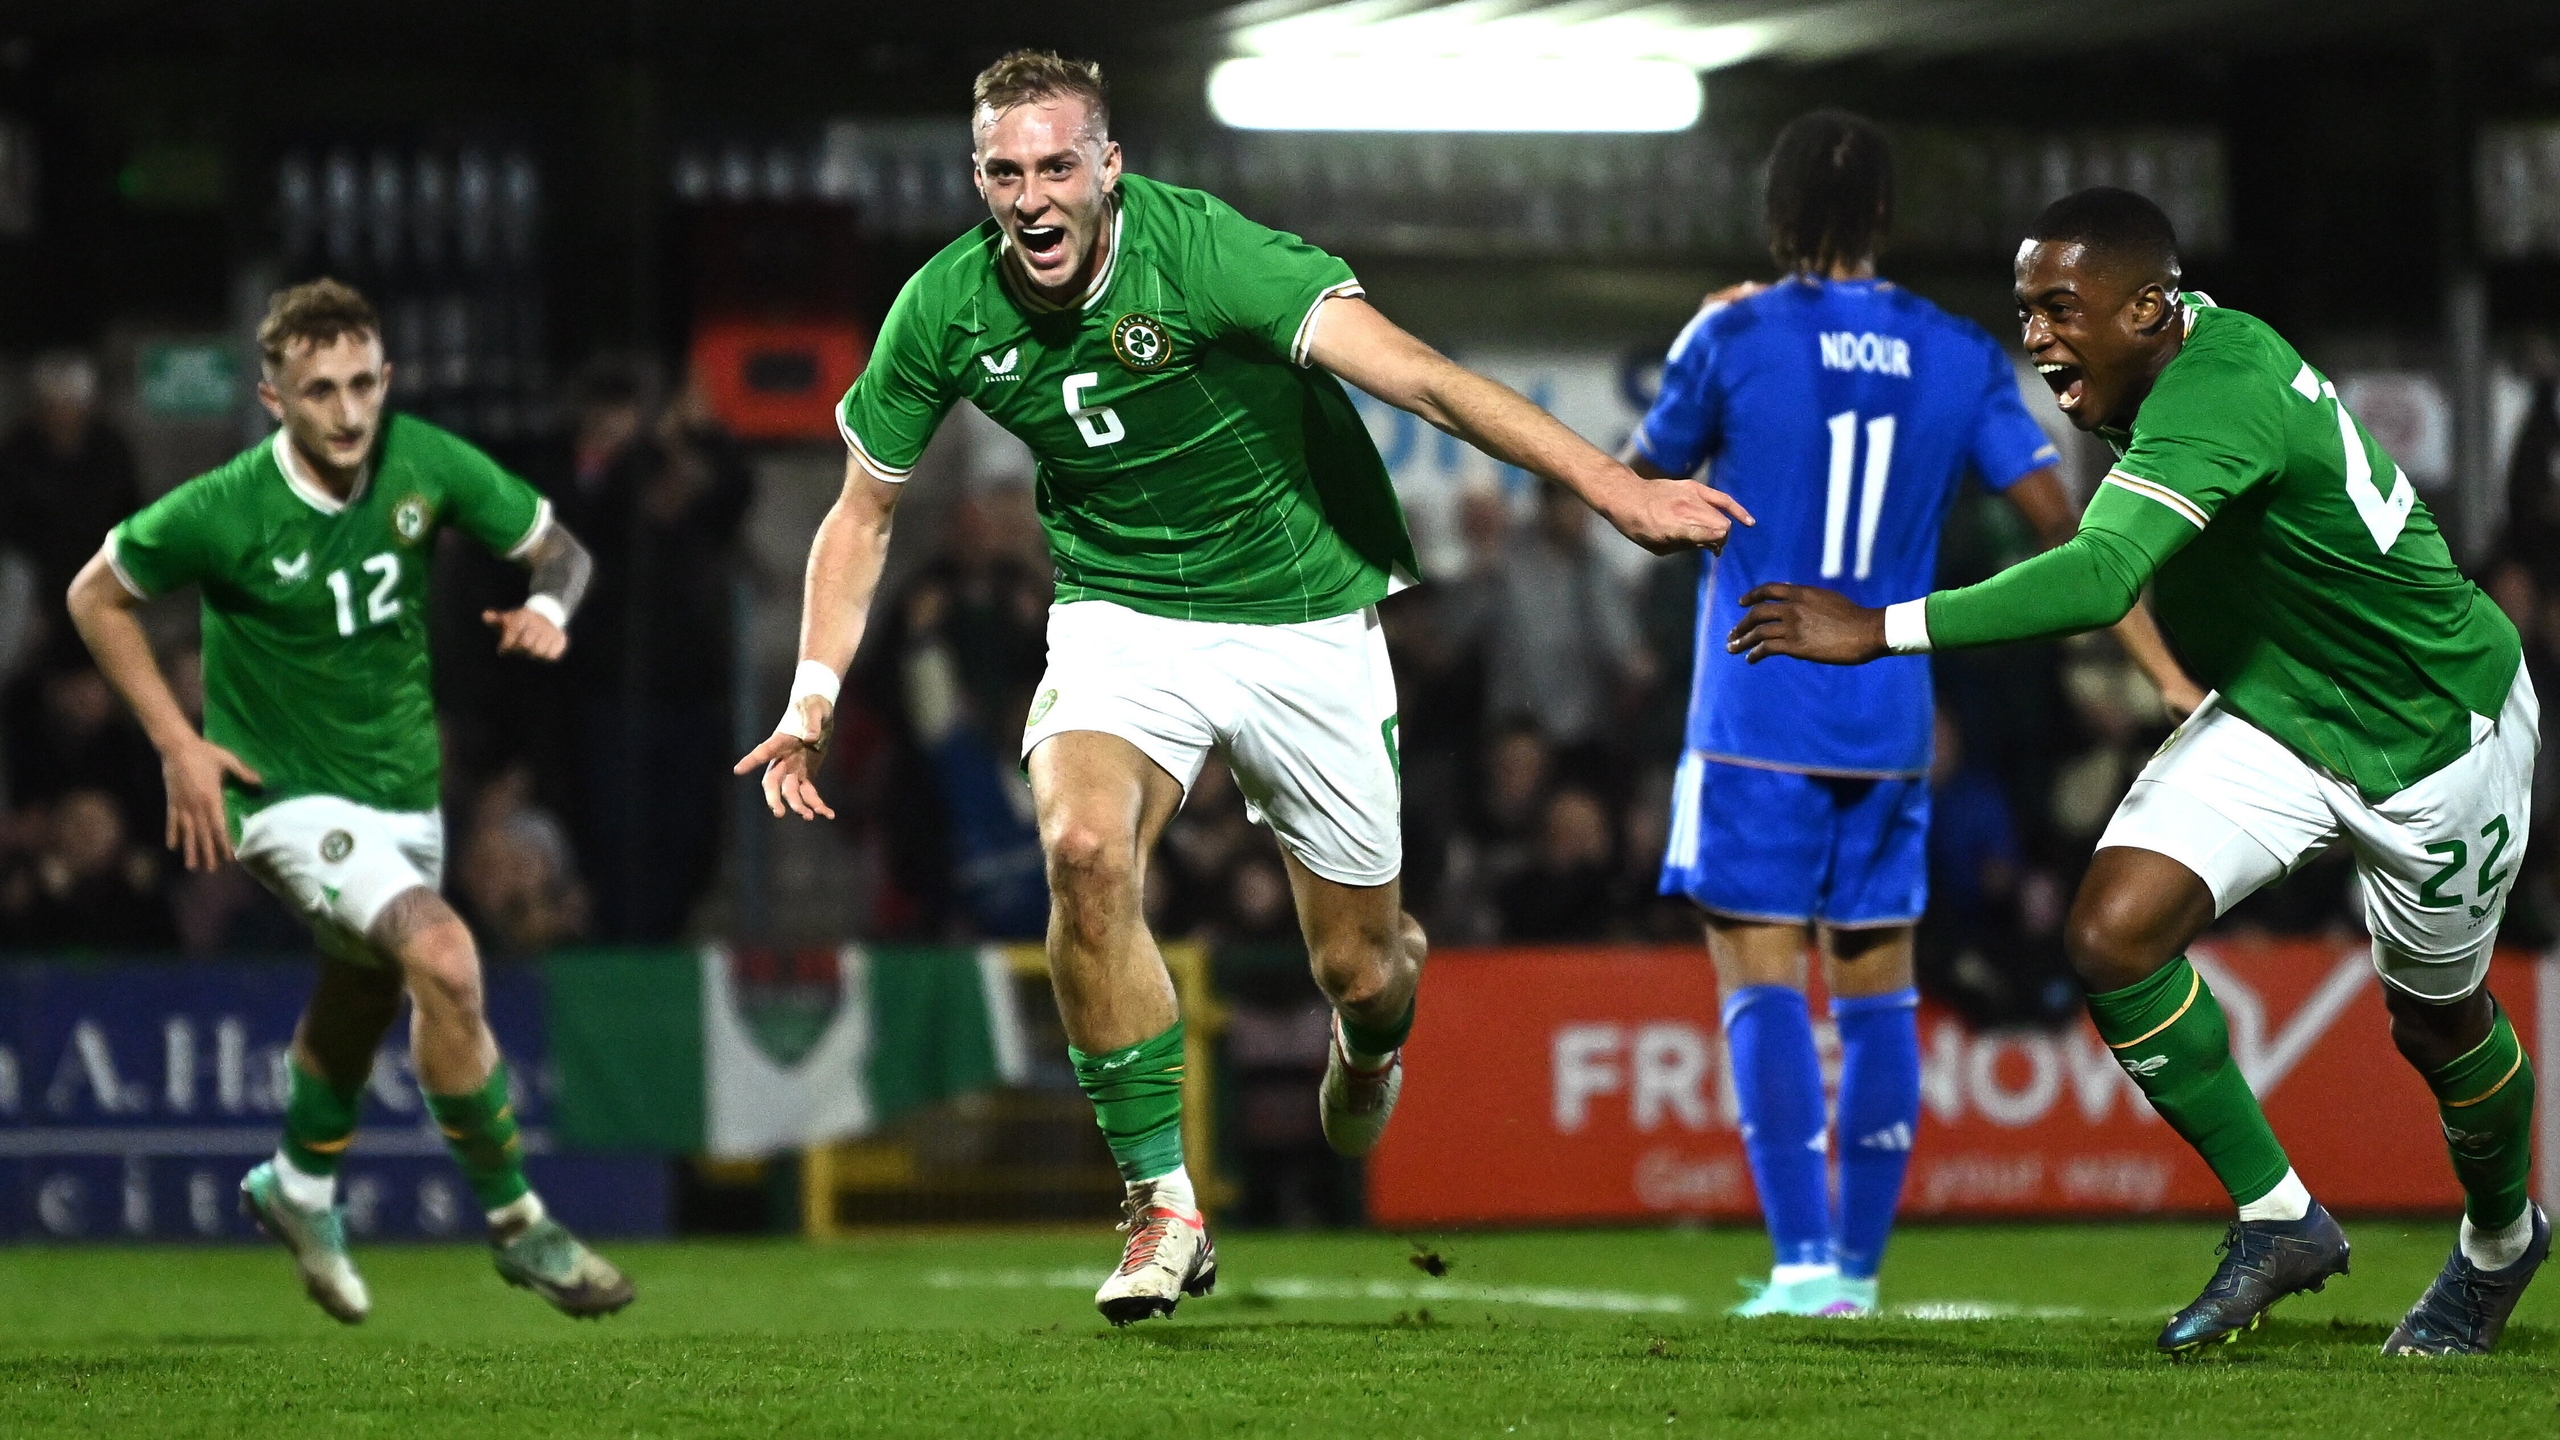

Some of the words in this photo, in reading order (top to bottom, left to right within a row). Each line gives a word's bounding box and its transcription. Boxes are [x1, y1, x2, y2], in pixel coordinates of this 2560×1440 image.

[1115, 316, 1160, 338] IRELAND
[1820, 332, 1911, 378] NDOUR
[985, 374, 1021, 383] CASTORE
[1062, 371, 1126, 448] 6
[1820, 410, 1896, 579] 11
[326, 551, 401, 637] 12
[2419, 813, 2510, 908] 22
